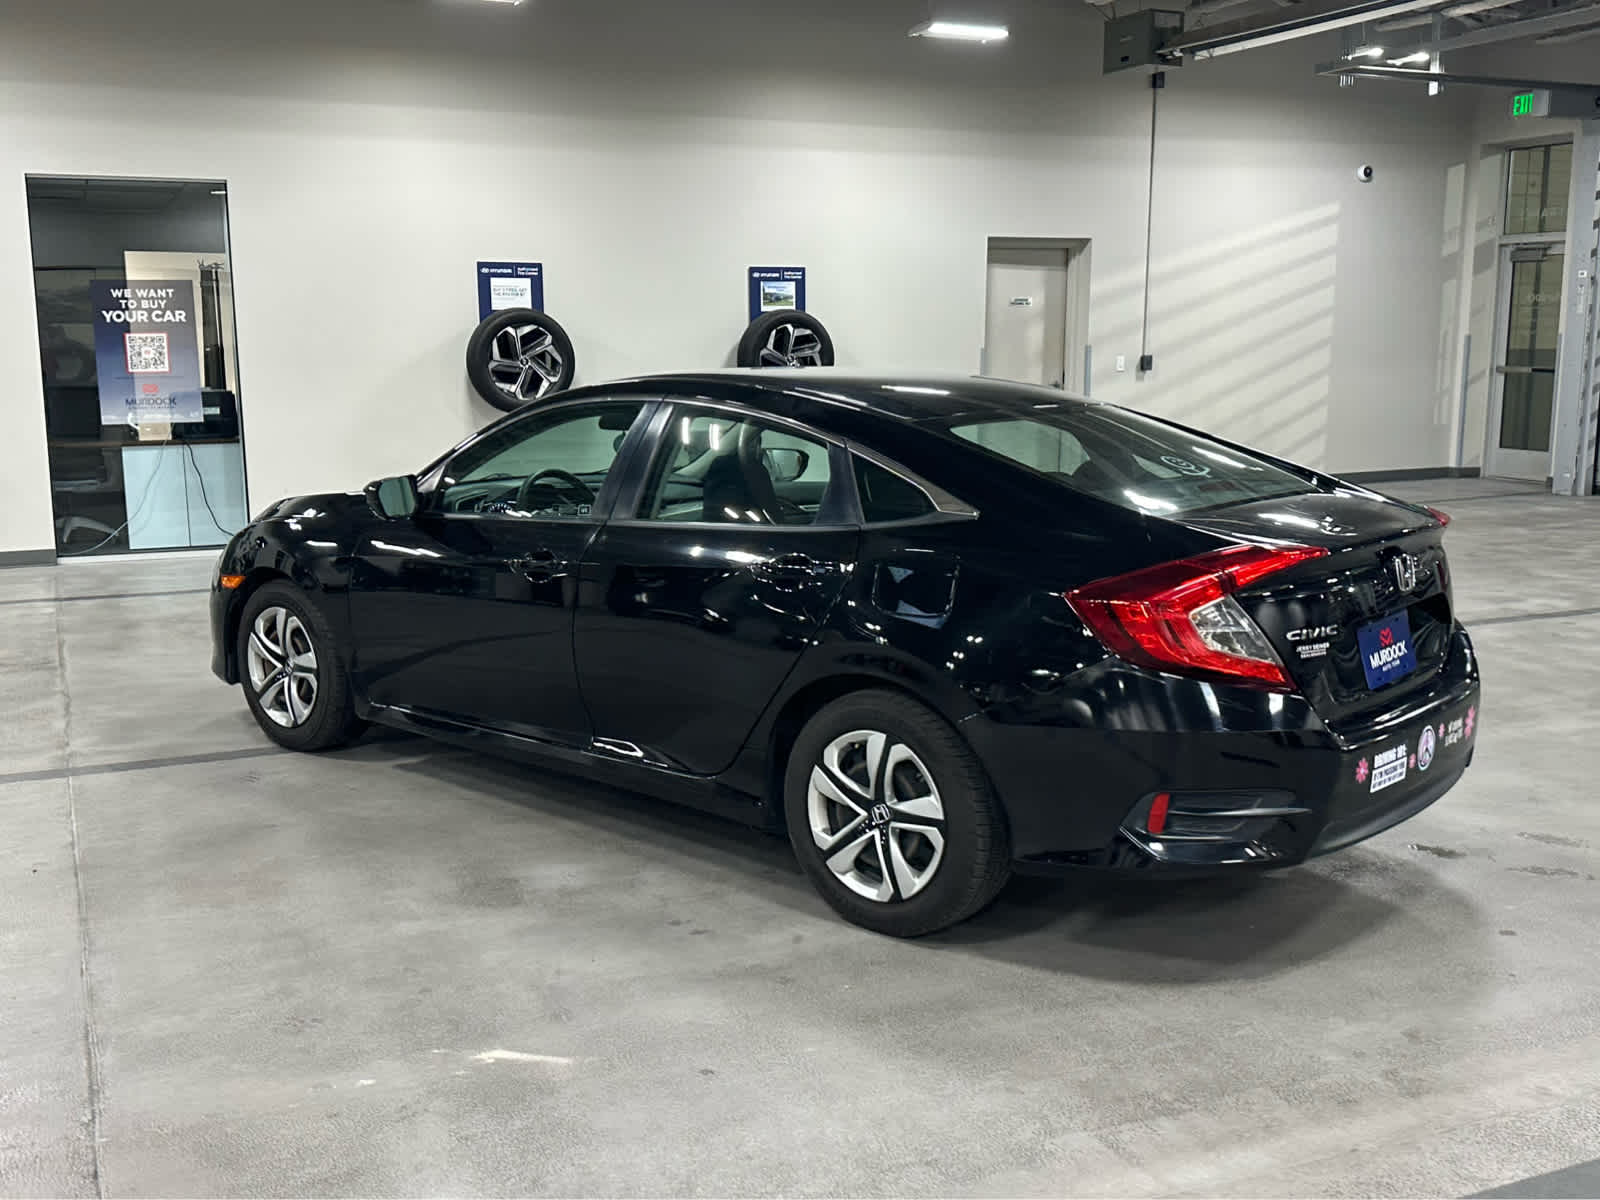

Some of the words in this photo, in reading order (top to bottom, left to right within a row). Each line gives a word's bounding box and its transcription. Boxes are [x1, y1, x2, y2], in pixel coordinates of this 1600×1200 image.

[1513, 92, 1534, 117] EXIT
[110, 288, 132, 298] WE
[135, 288, 175, 298] WANT
[119, 299, 137, 309] TO
[141, 299, 167, 309] BUY
[102, 310, 149, 322] YOUR
[151, 310, 187, 322] CAR
[125, 396, 177, 406] MURDOCK
[1286, 624, 1338, 641] CIVIC
[1369, 640, 1408, 670] MURDOCK
